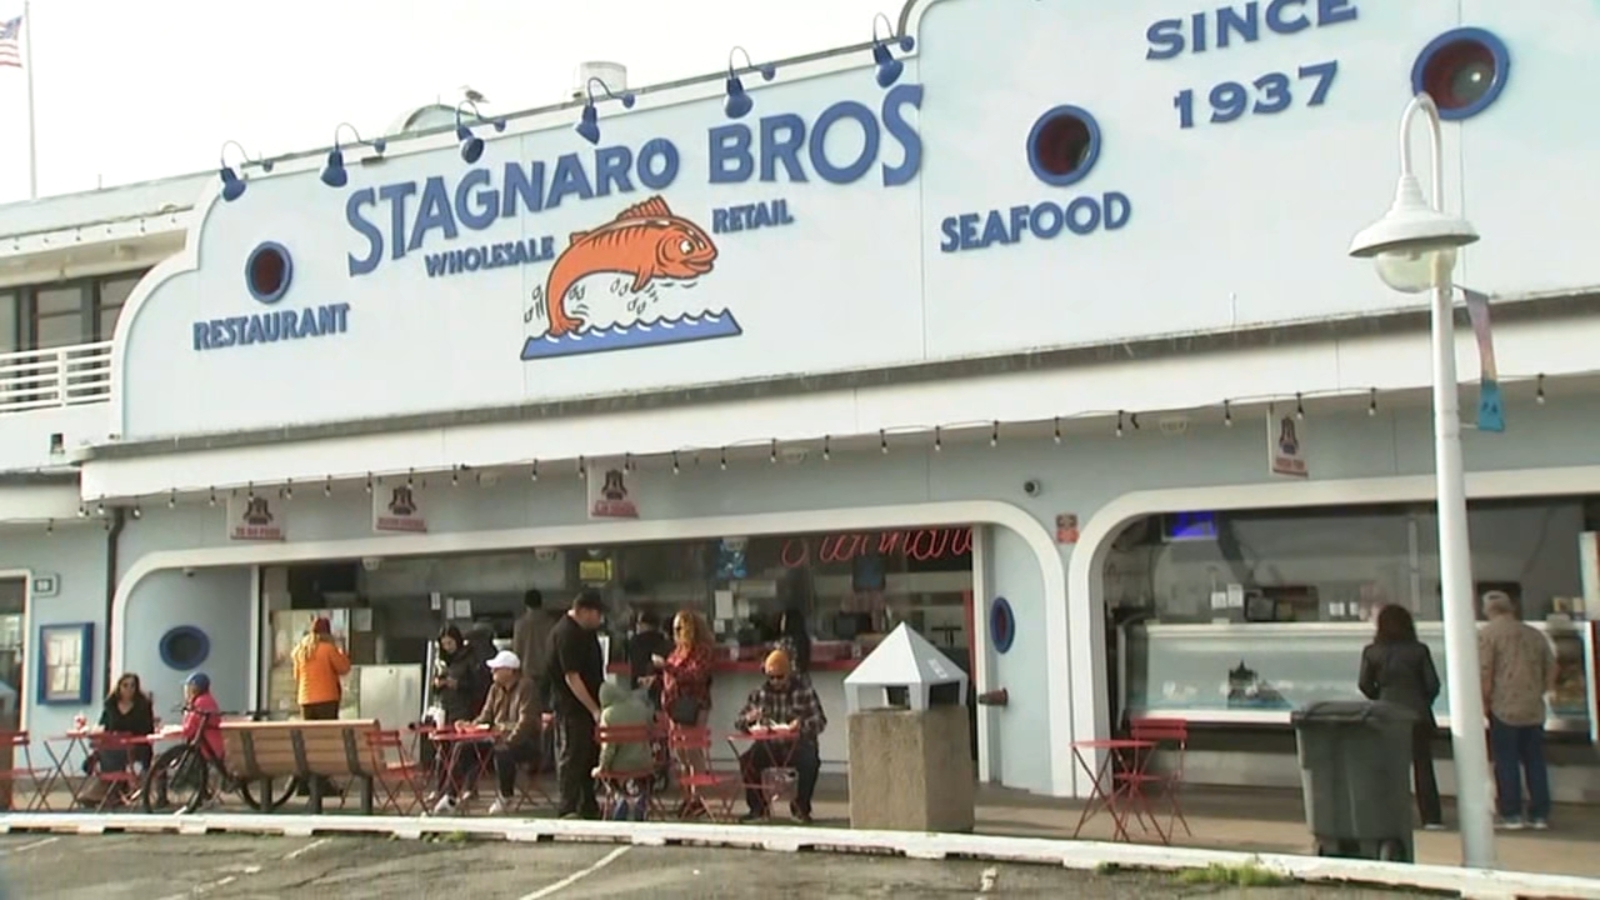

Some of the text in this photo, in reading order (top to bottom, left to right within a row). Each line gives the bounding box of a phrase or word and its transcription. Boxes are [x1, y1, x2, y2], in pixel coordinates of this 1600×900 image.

[1146, 0, 1358, 60] SINCE
[1173, 59, 1339, 129] 1937
[346, 84, 924, 276] STAGNARO BROS
[712, 199, 794, 235] RETAIL
[940, 191, 1132, 253] SEAFOOD
[424, 236, 555, 277] WHOLESALE
[193, 302, 350, 350] RESTAURANT
